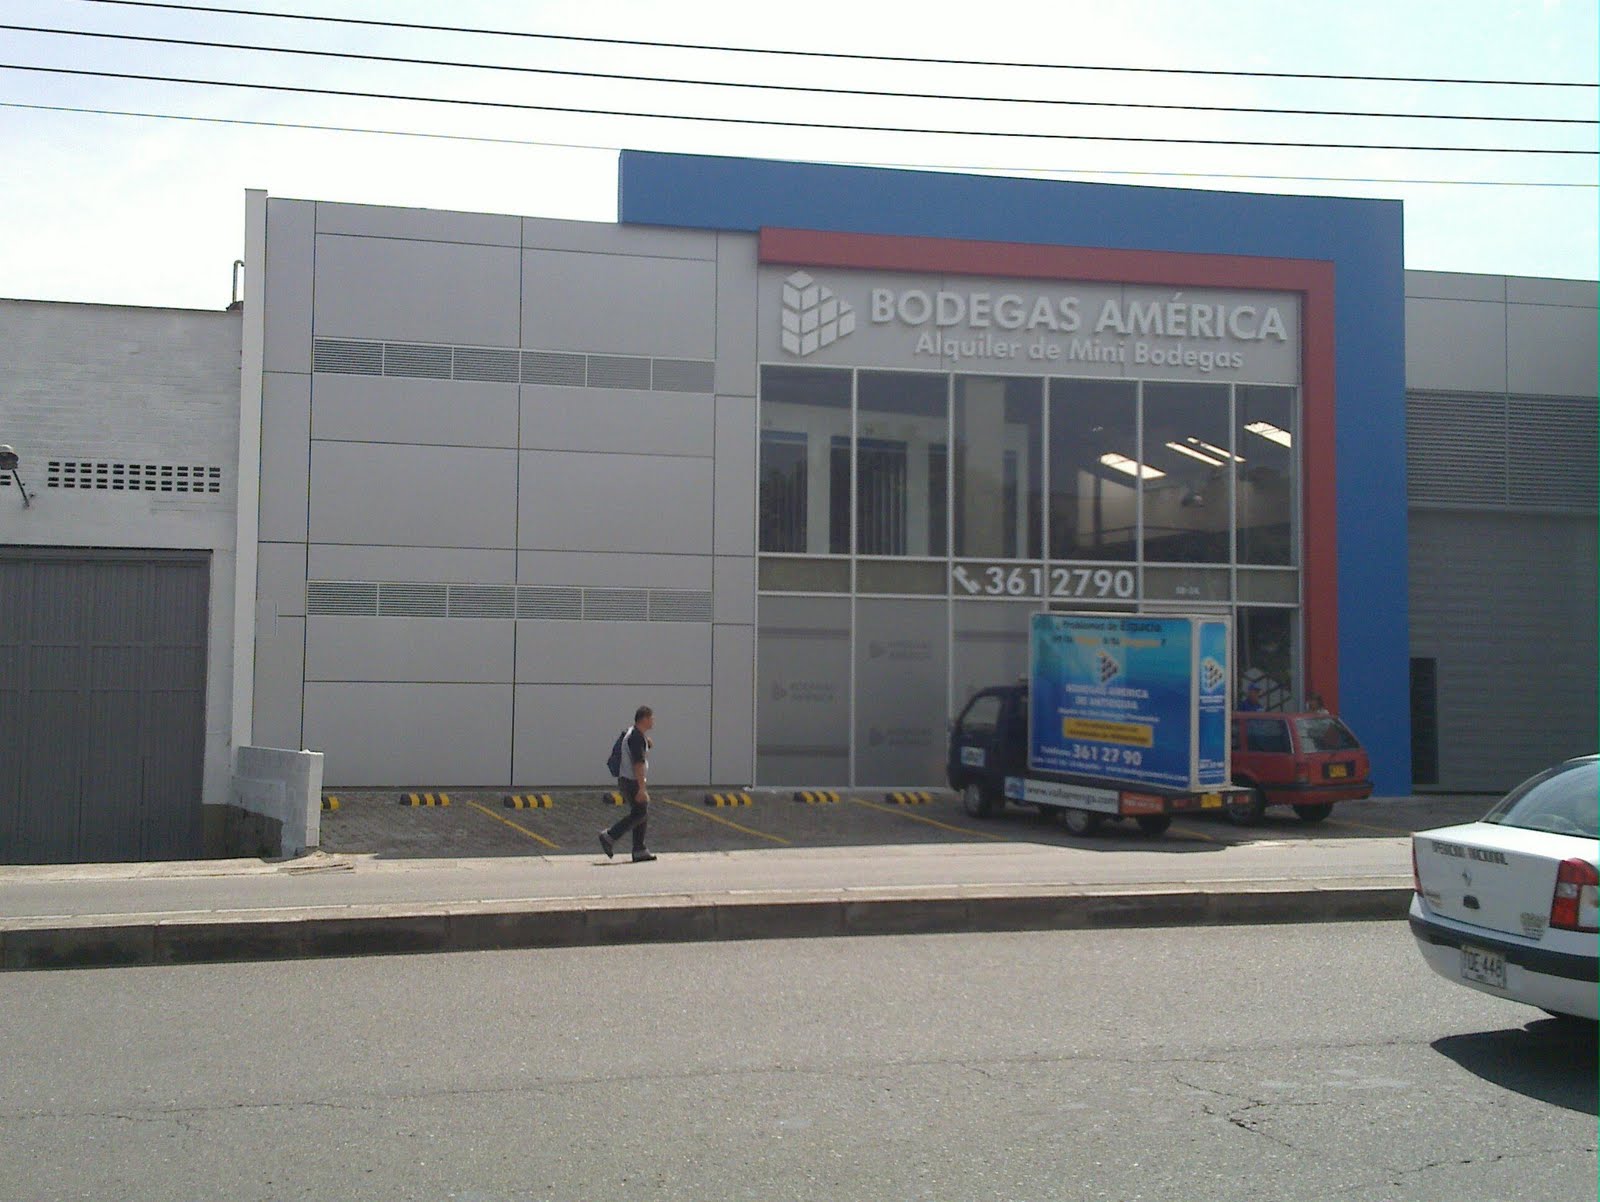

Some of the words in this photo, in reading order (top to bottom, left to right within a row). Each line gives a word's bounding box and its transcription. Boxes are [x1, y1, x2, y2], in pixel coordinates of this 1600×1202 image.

[871, 288, 1080, 332] BODEGAS
[1094, 292, 1288, 342] AMÉRICA
[914, 329, 1021, 363] Alquiler
[1028, 335, 1060, 360] de
[1069, 337, 1126, 362] Mini
[1133, 341, 1243, 372] Bodegas
[1071, 743, 1099, 760] 361
[1122, 750, 1143, 766] 90
